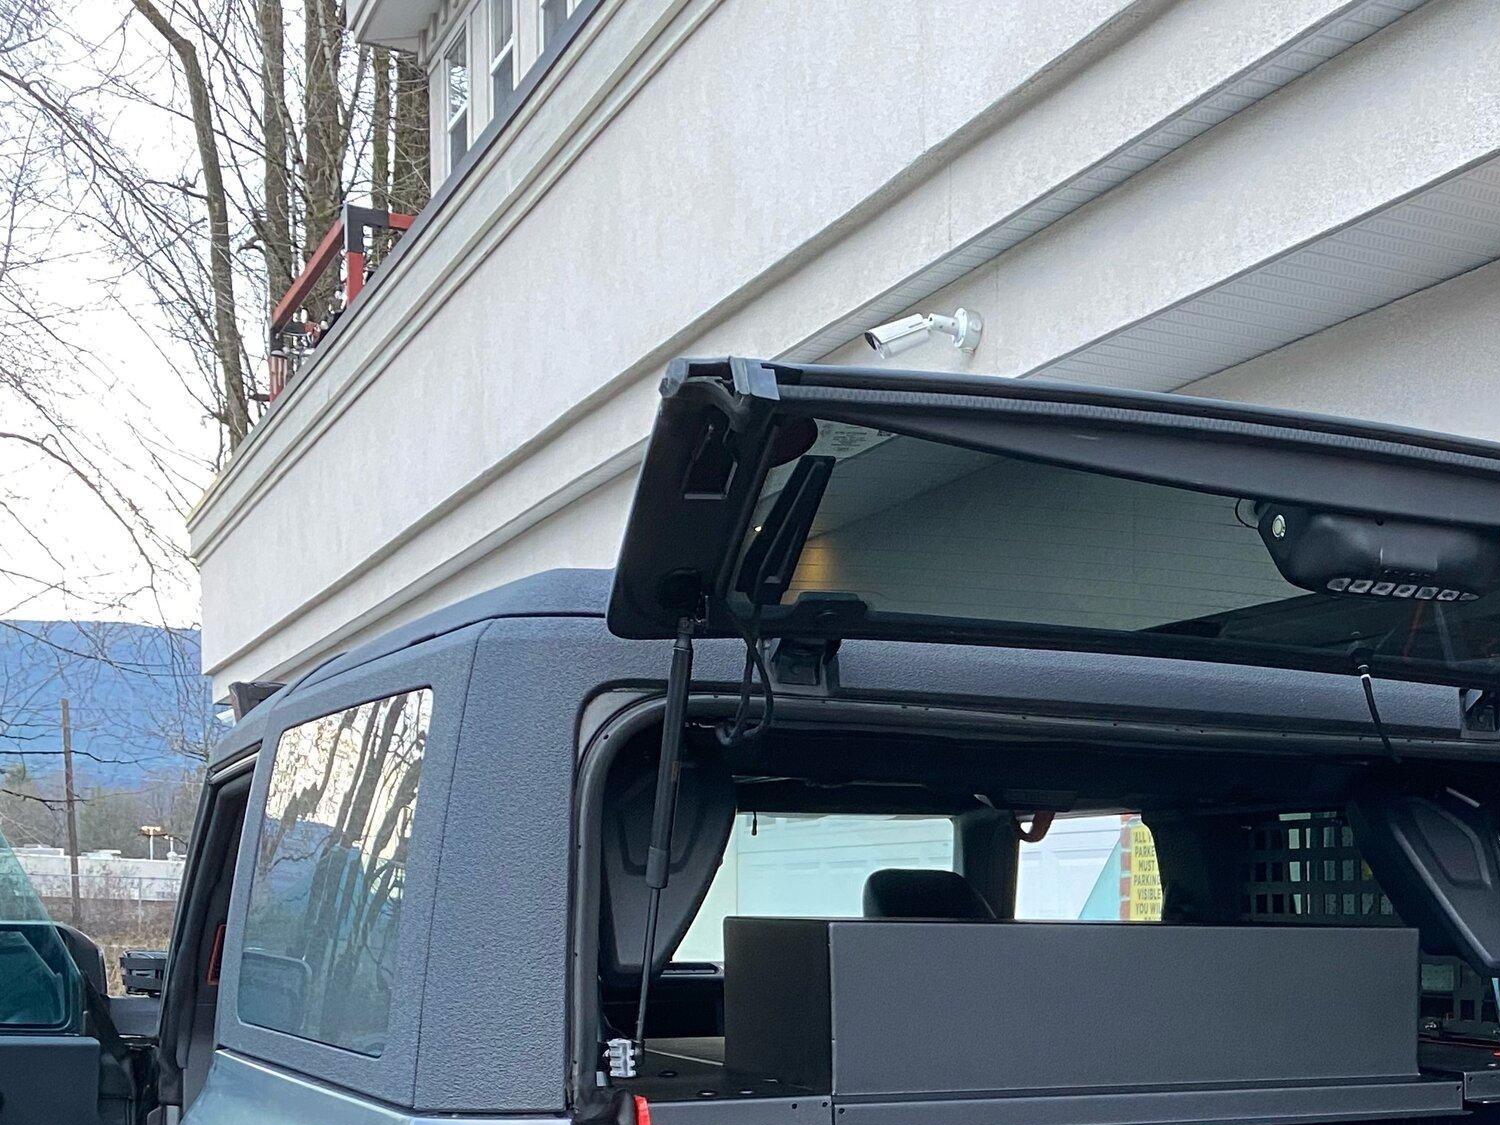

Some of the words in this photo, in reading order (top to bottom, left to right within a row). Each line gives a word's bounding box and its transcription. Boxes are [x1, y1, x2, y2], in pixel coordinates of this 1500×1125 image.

[1139, 860, 1155, 872] MUST
[1137, 888, 1161, 900] VISIBLE
[1136, 902, 1148, 915] YOU
